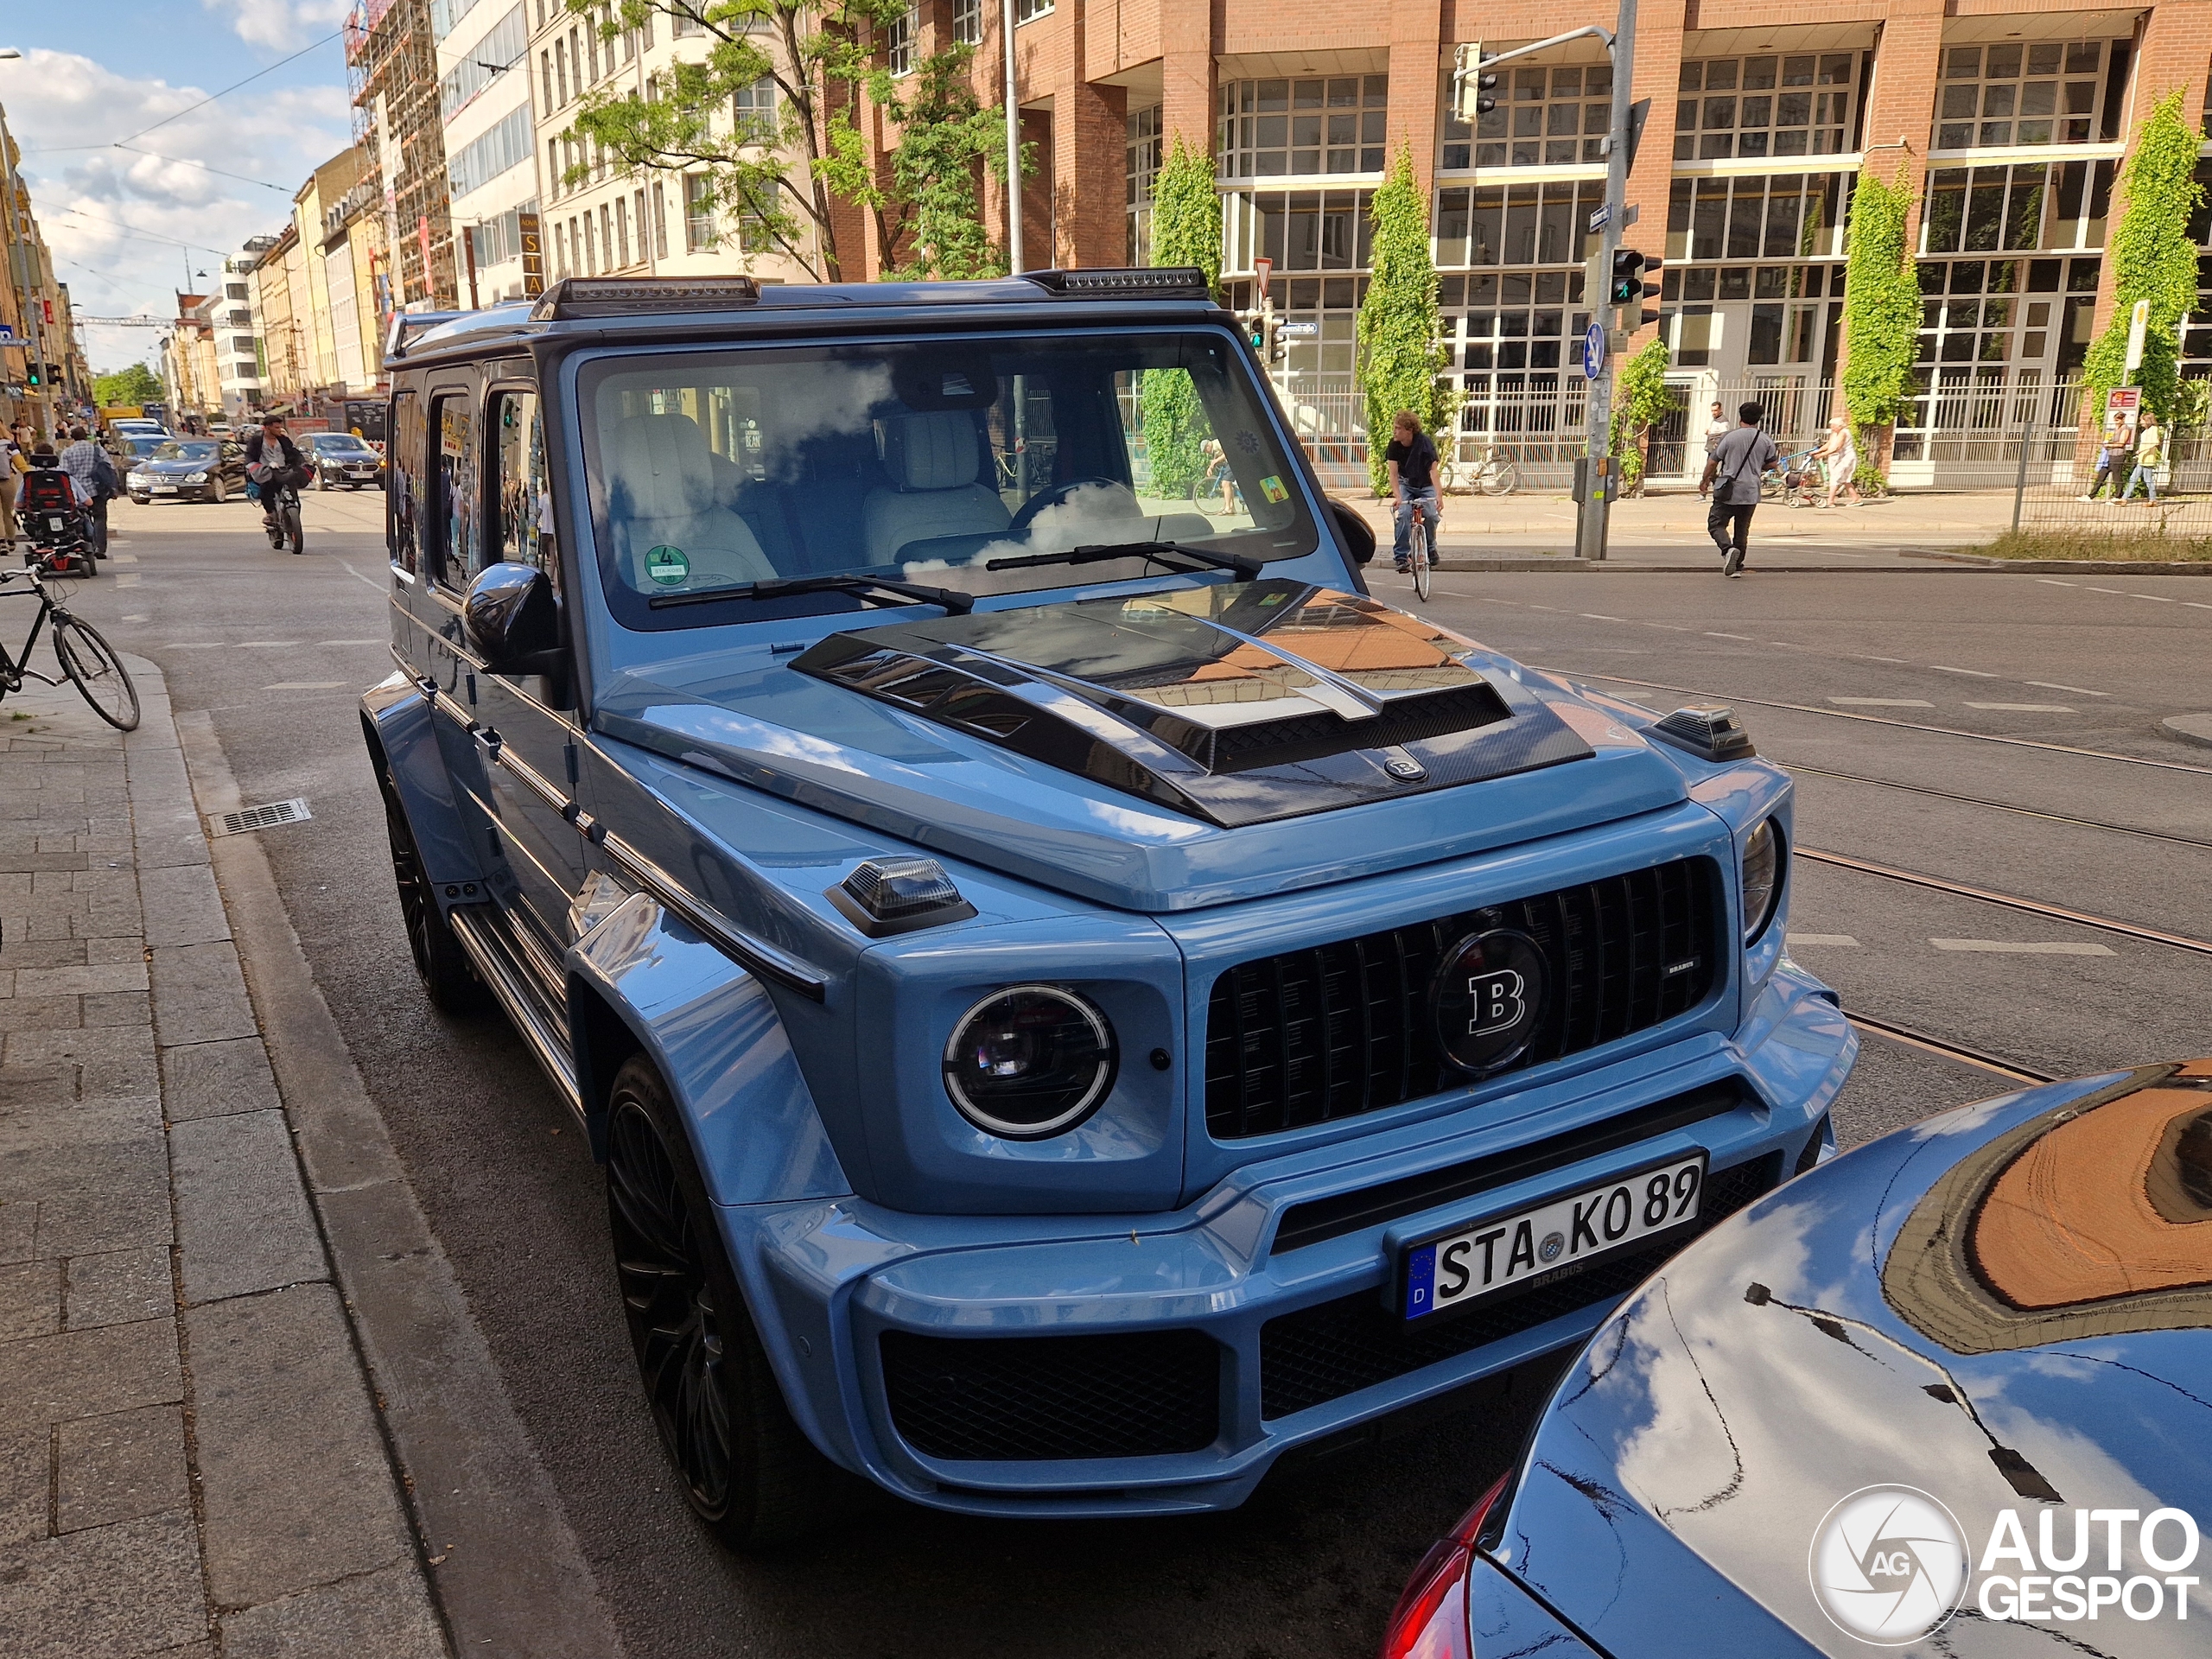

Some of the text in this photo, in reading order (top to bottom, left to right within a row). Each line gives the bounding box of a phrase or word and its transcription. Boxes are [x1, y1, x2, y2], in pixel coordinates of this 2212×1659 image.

[659, 547, 674, 565] 4
[1669, 961, 1694, 974] BRABUS
[1469, 969, 1525, 1037] B
[1439, 1164, 1700, 1299] STA KO 89
[1532, 1262, 1585, 1289] BRABUS
[1413, 1288, 1425, 1305] D
